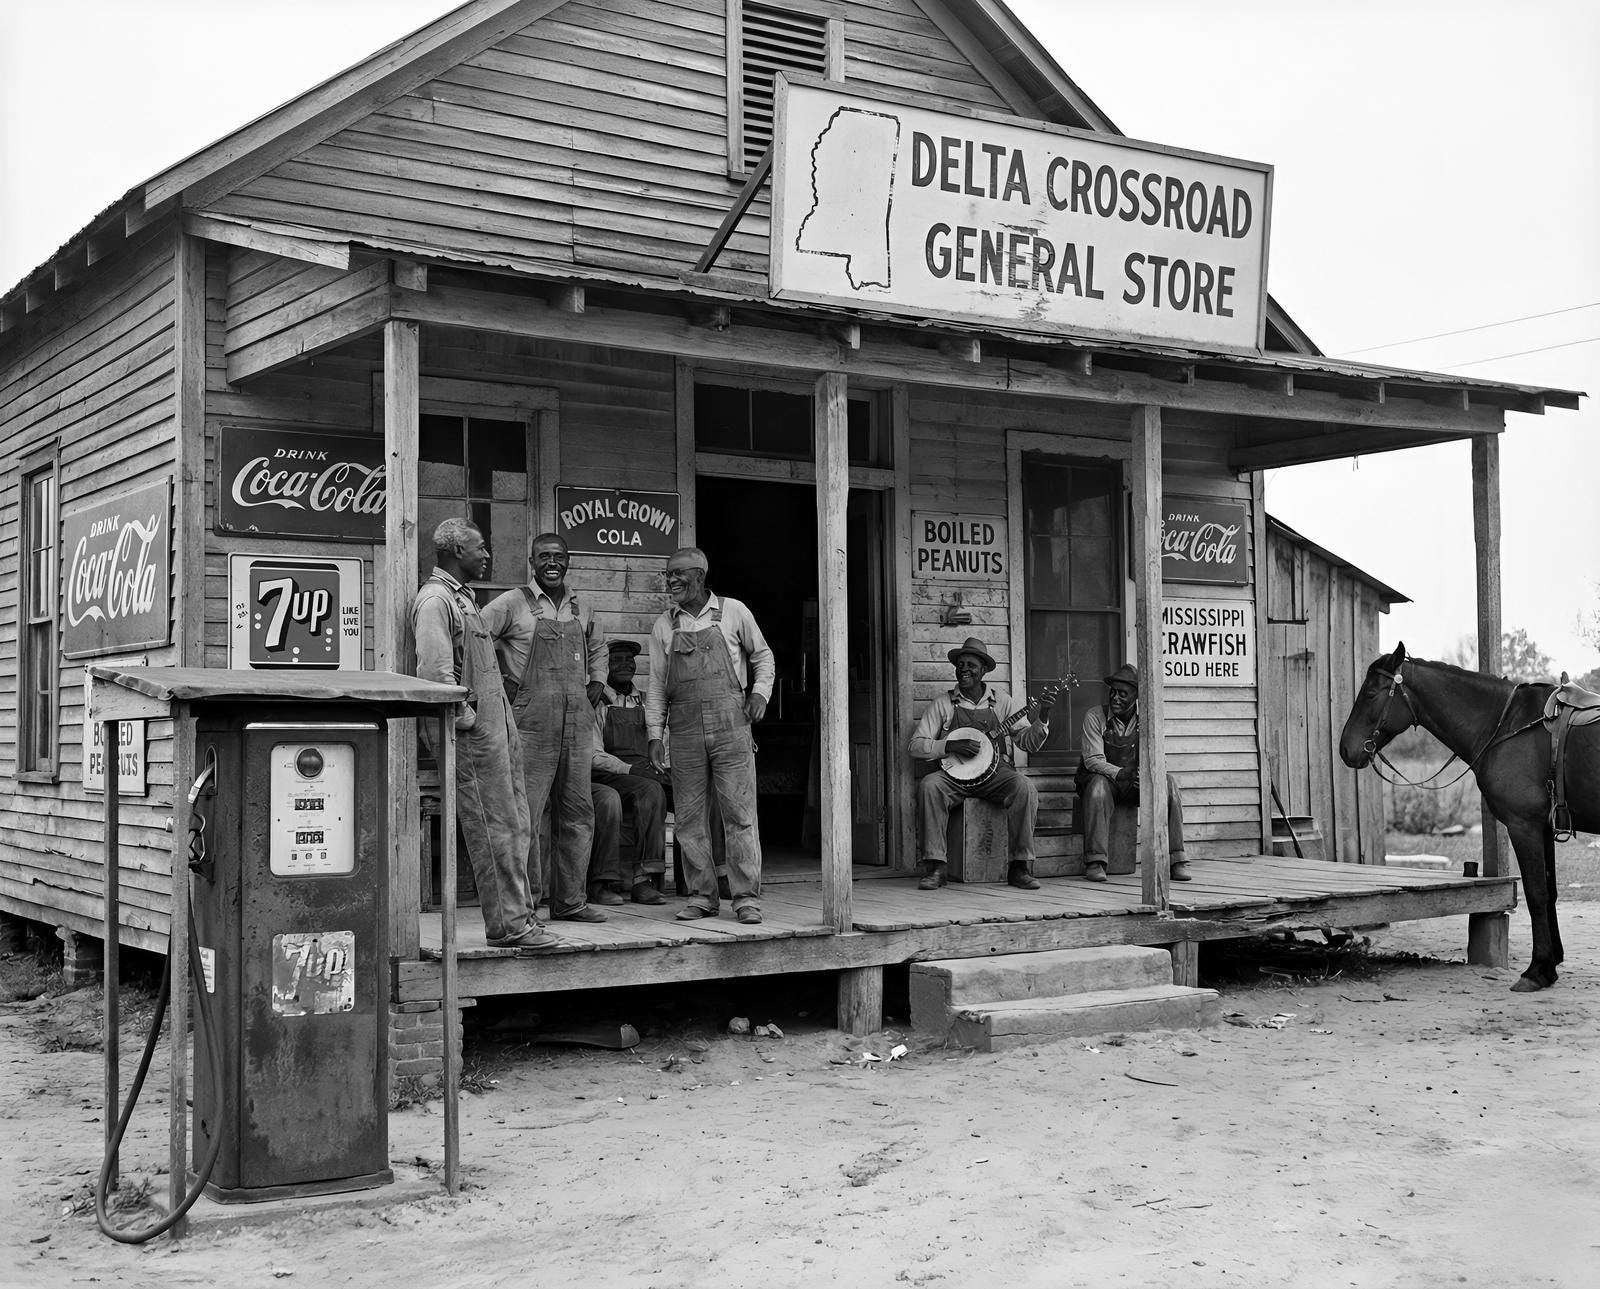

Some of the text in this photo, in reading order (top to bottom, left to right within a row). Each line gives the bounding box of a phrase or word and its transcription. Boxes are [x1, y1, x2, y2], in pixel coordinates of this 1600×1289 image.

[912, 131, 1252, 239] DELTA CROSSROAD
[925, 223, 1236, 317] GENERAL STORE
[274, 449, 329, 461] DRINK
[231, 456, 387, 515] Coca-Cola
[90, 514, 121, 538] DRINK
[560, 498, 676, 536] ROYAL CROWN
[1168, 512, 1200, 522] DRINK
[597, 528, 642, 546] COLA
[924, 520, 995, 545] BOILED
[68, 511, 162, 628] Coca-Cola
[918, 548, 1003, 574] PEANUTS
[342, 606, 359, 615] LIKE
[343, 627, 359, 637] YOU
[1162, 631, 1247, 656] RAWFISH
[1165, 661, 1239, 677] SOLD HERE
[90, 752, 138, 776] PEUTS
